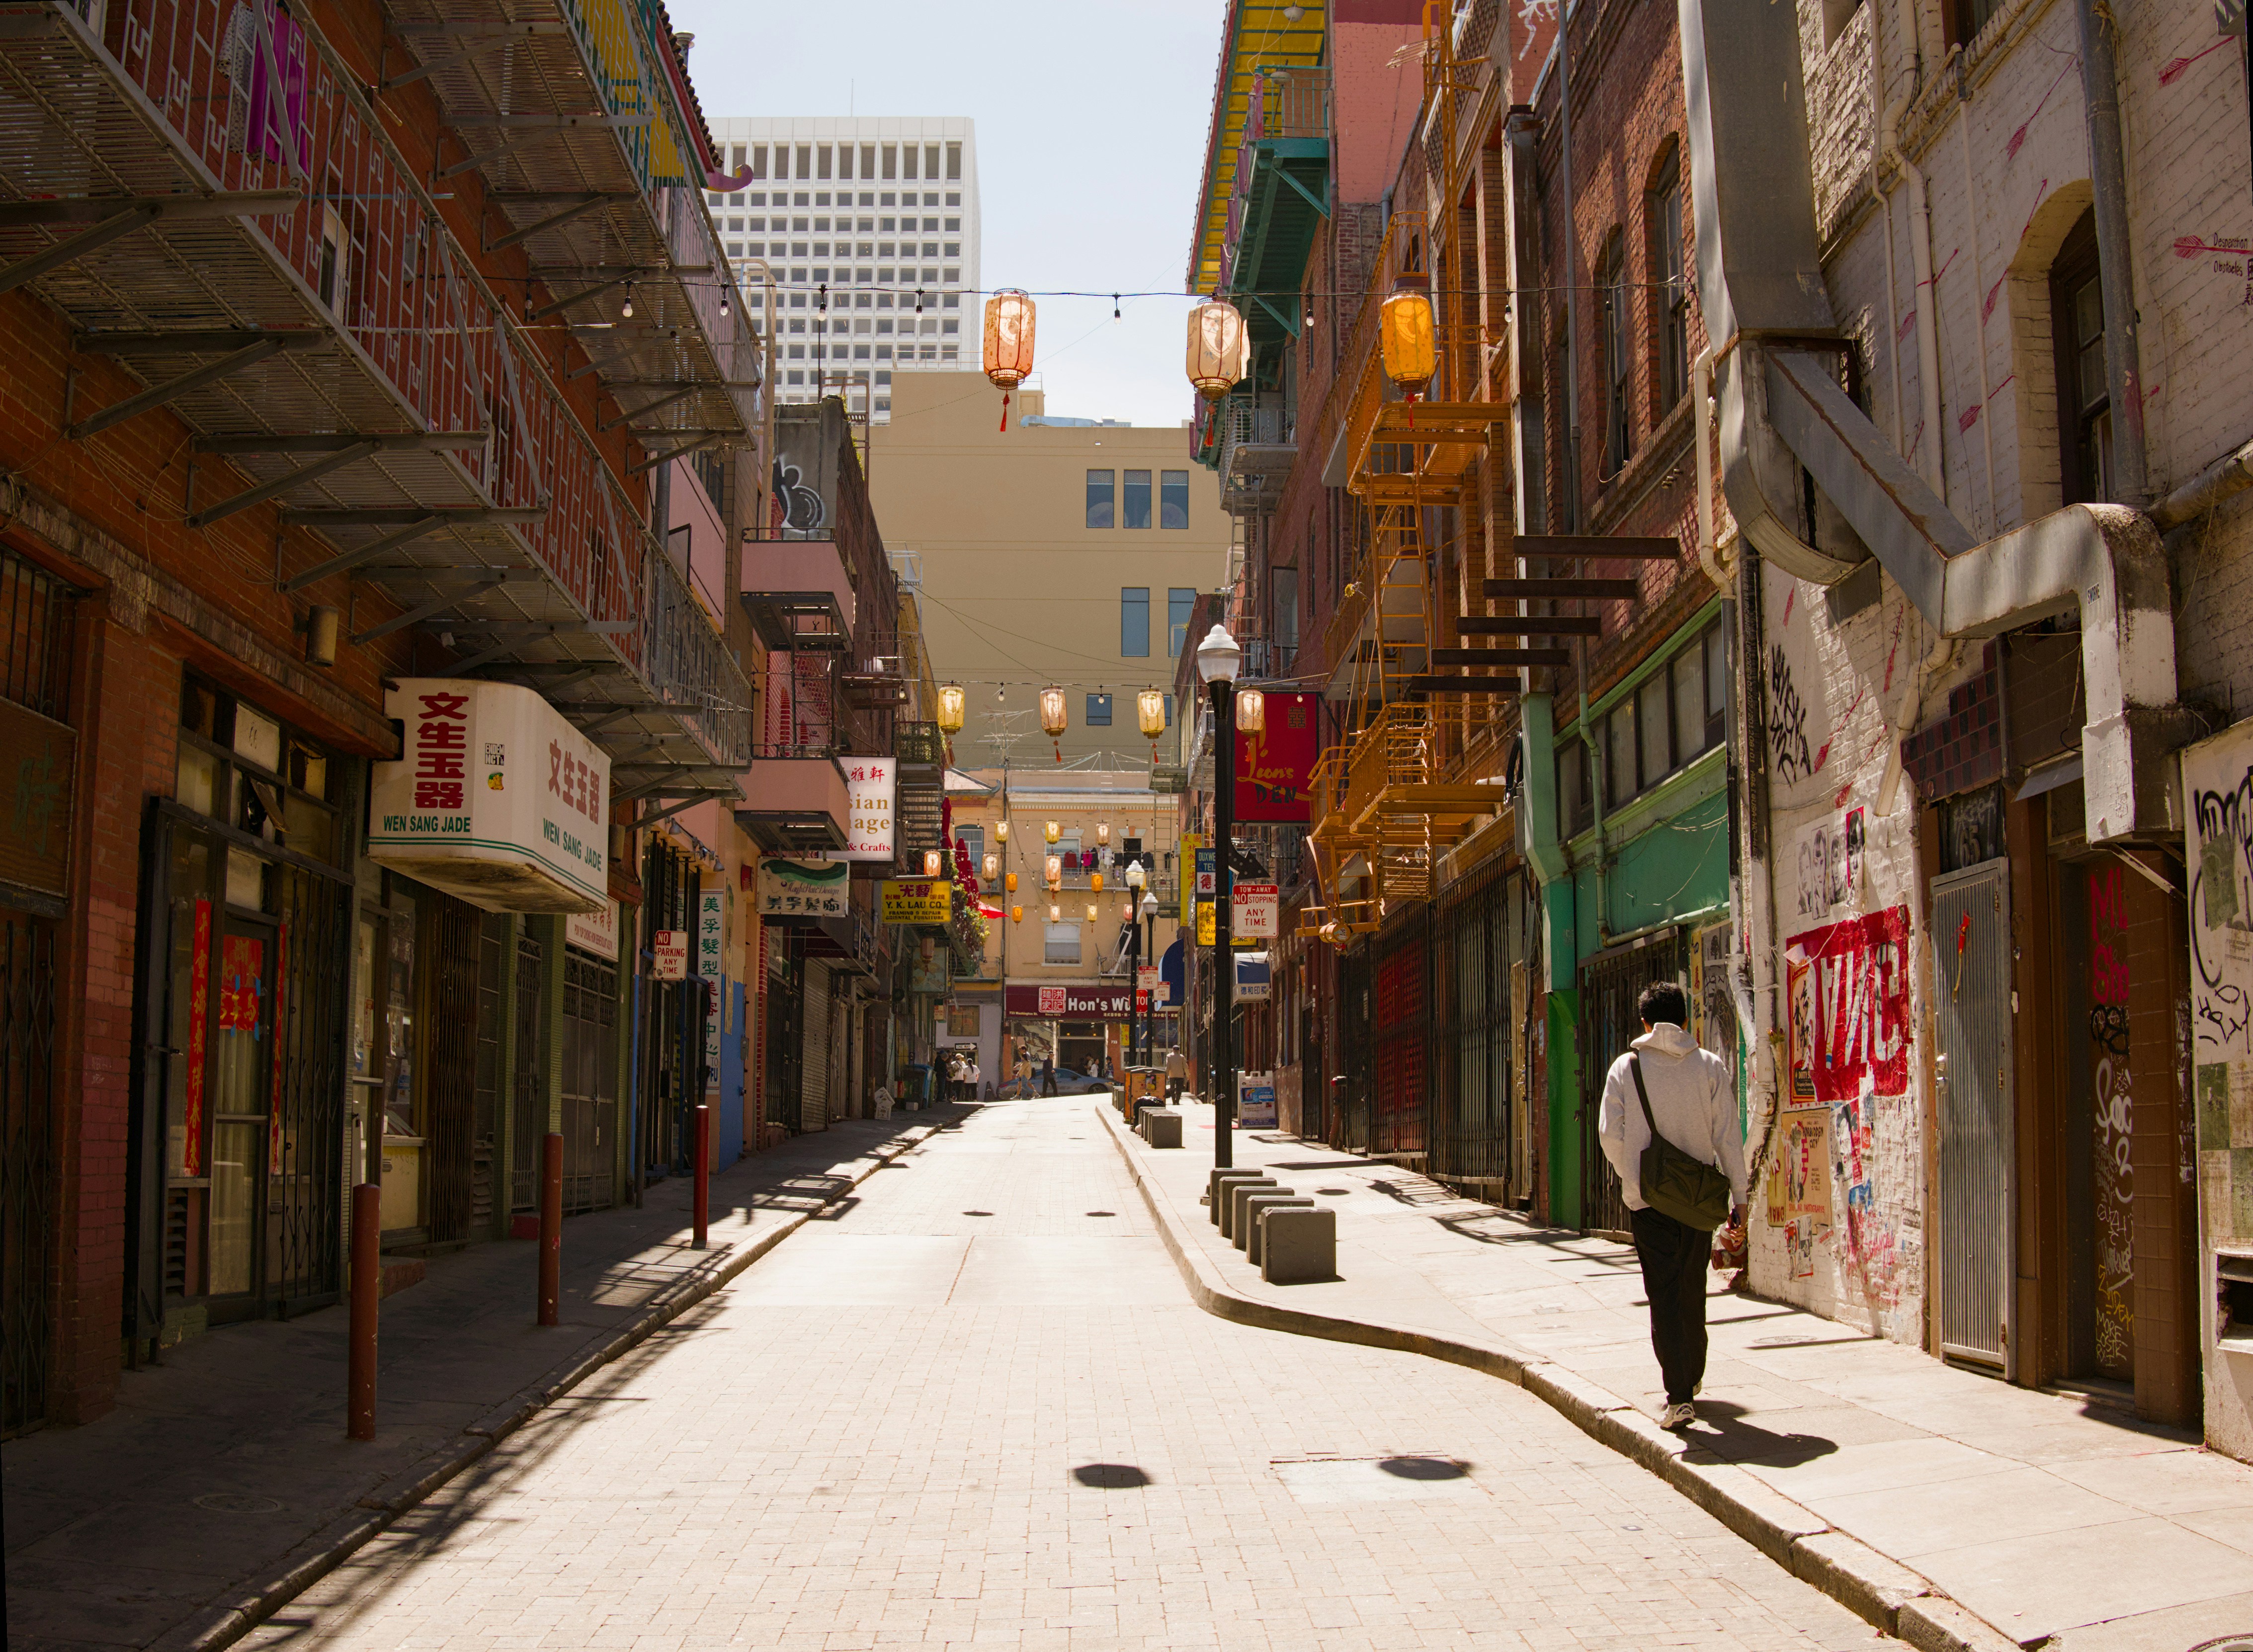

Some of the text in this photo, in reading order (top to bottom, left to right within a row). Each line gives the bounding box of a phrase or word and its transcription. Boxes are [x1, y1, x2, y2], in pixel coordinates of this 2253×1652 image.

[2213, 232, 2248, 249] Desperation
[2214, 260, 2243, 277] Obstacles
[415, 692, 469, 809] 文生玉器
[549, 739, 599, 825] 文生玉器
[848, 766, 885, 783] 雅軒
[849, 793, 889, 810] sian
[1255, 784, 1297, 804] DEN
[384, 816, 471, 832] WEN SANG JADE
[849, 818, 890, 834] age
[543, 818, 602, 872] WEN SANG JADE
[860, 843, 891, 851] Crafts
[1198, 852, 1216, 862] DUXWE
[820, 885, 839, 896] Design
[1235, 894, 1247, 904] NO
[658, 933, 668, 944] NO
[657, 947, 685, 957] PARKING
[1068, 997, 1131, 1011] Hon's Wu
[1136, 996, 1148, 1005] TO
